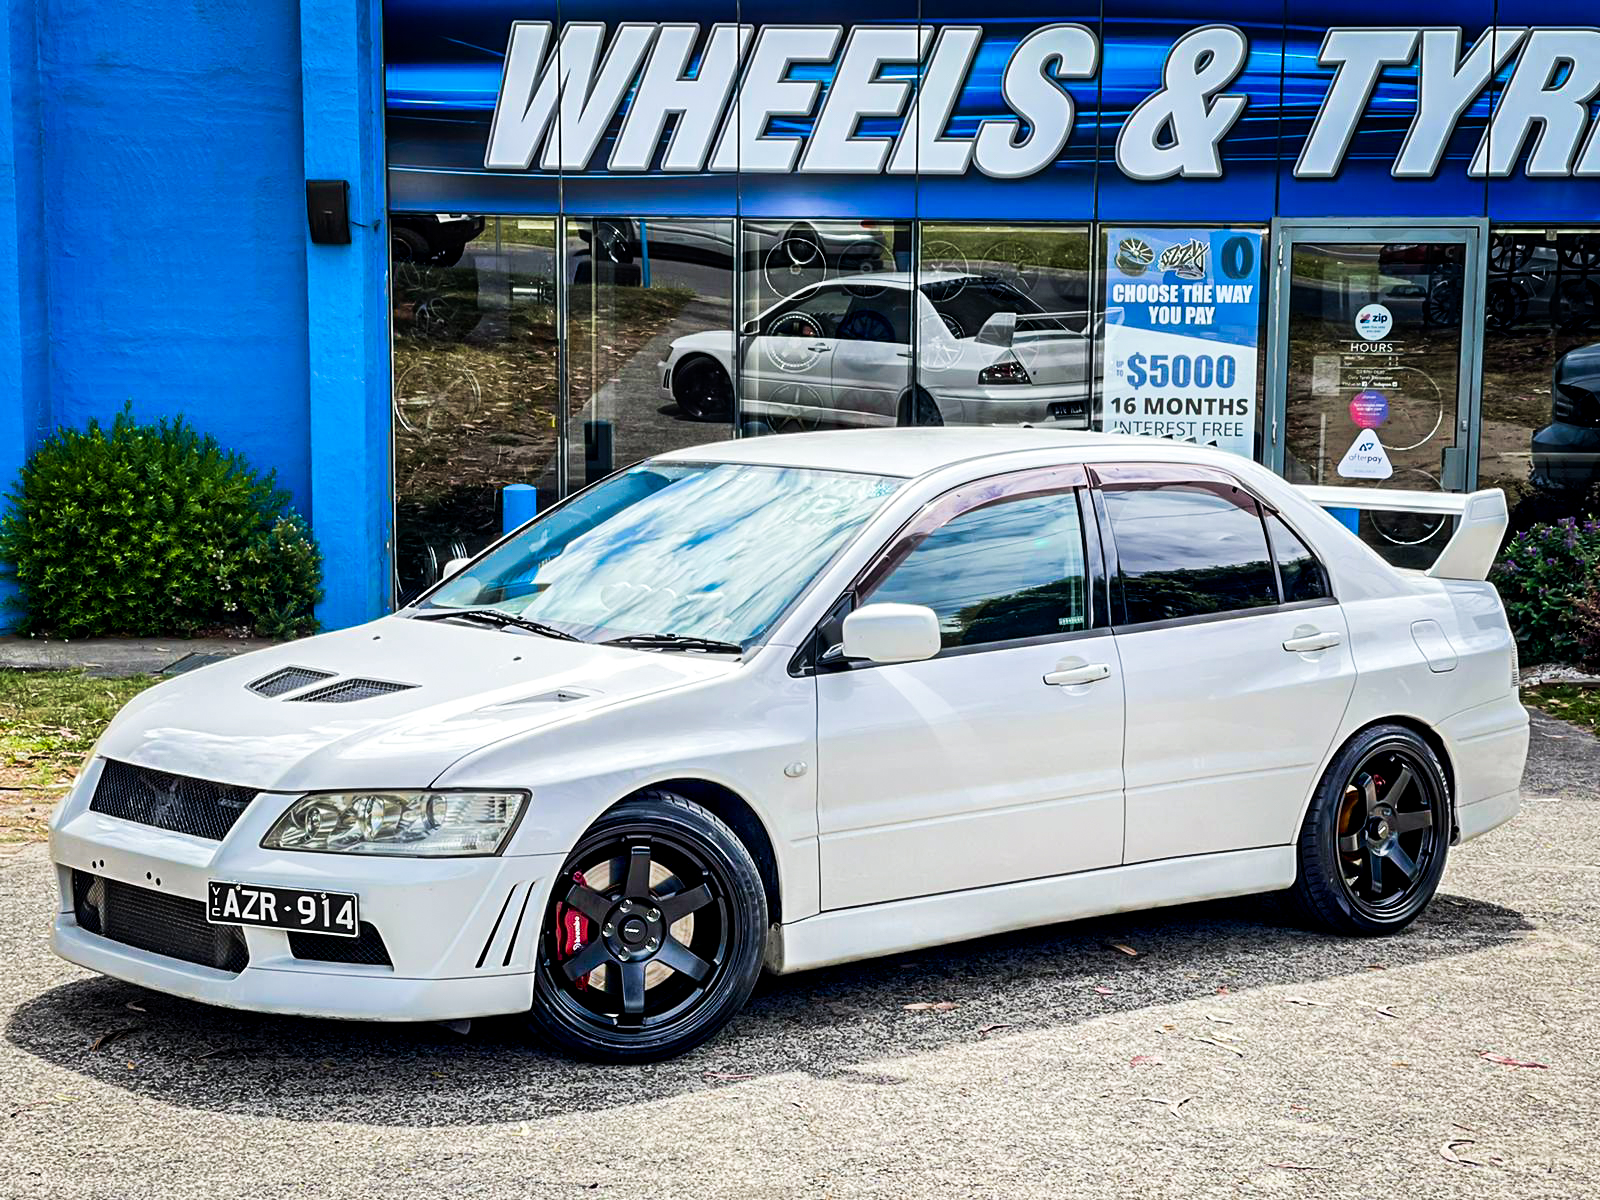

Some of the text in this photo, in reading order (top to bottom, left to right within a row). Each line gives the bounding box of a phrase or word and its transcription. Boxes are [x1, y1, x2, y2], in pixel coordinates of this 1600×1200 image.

[484, 21, 1099, 179] WHEELS
[1115, 24, 1248, 181] &
[1112, 284, 1254, 304] CHOOSE THE WAY
[1148, 306, 1216, 325] YOU PAY
[1372, 312, 1388, 324] zip
[1350, 342, 1394, 353] HOURS
[1116, 360, 1124, 368] UP
[1126, 352, 1237, 390] $5000
[1110, 397, 1249, 416] 16 MONTHS
[1202, 421, 1244, 437] FREE
[1348, 453, 1383, 464] afterpay
[211, 886, 222, 917] VIC
